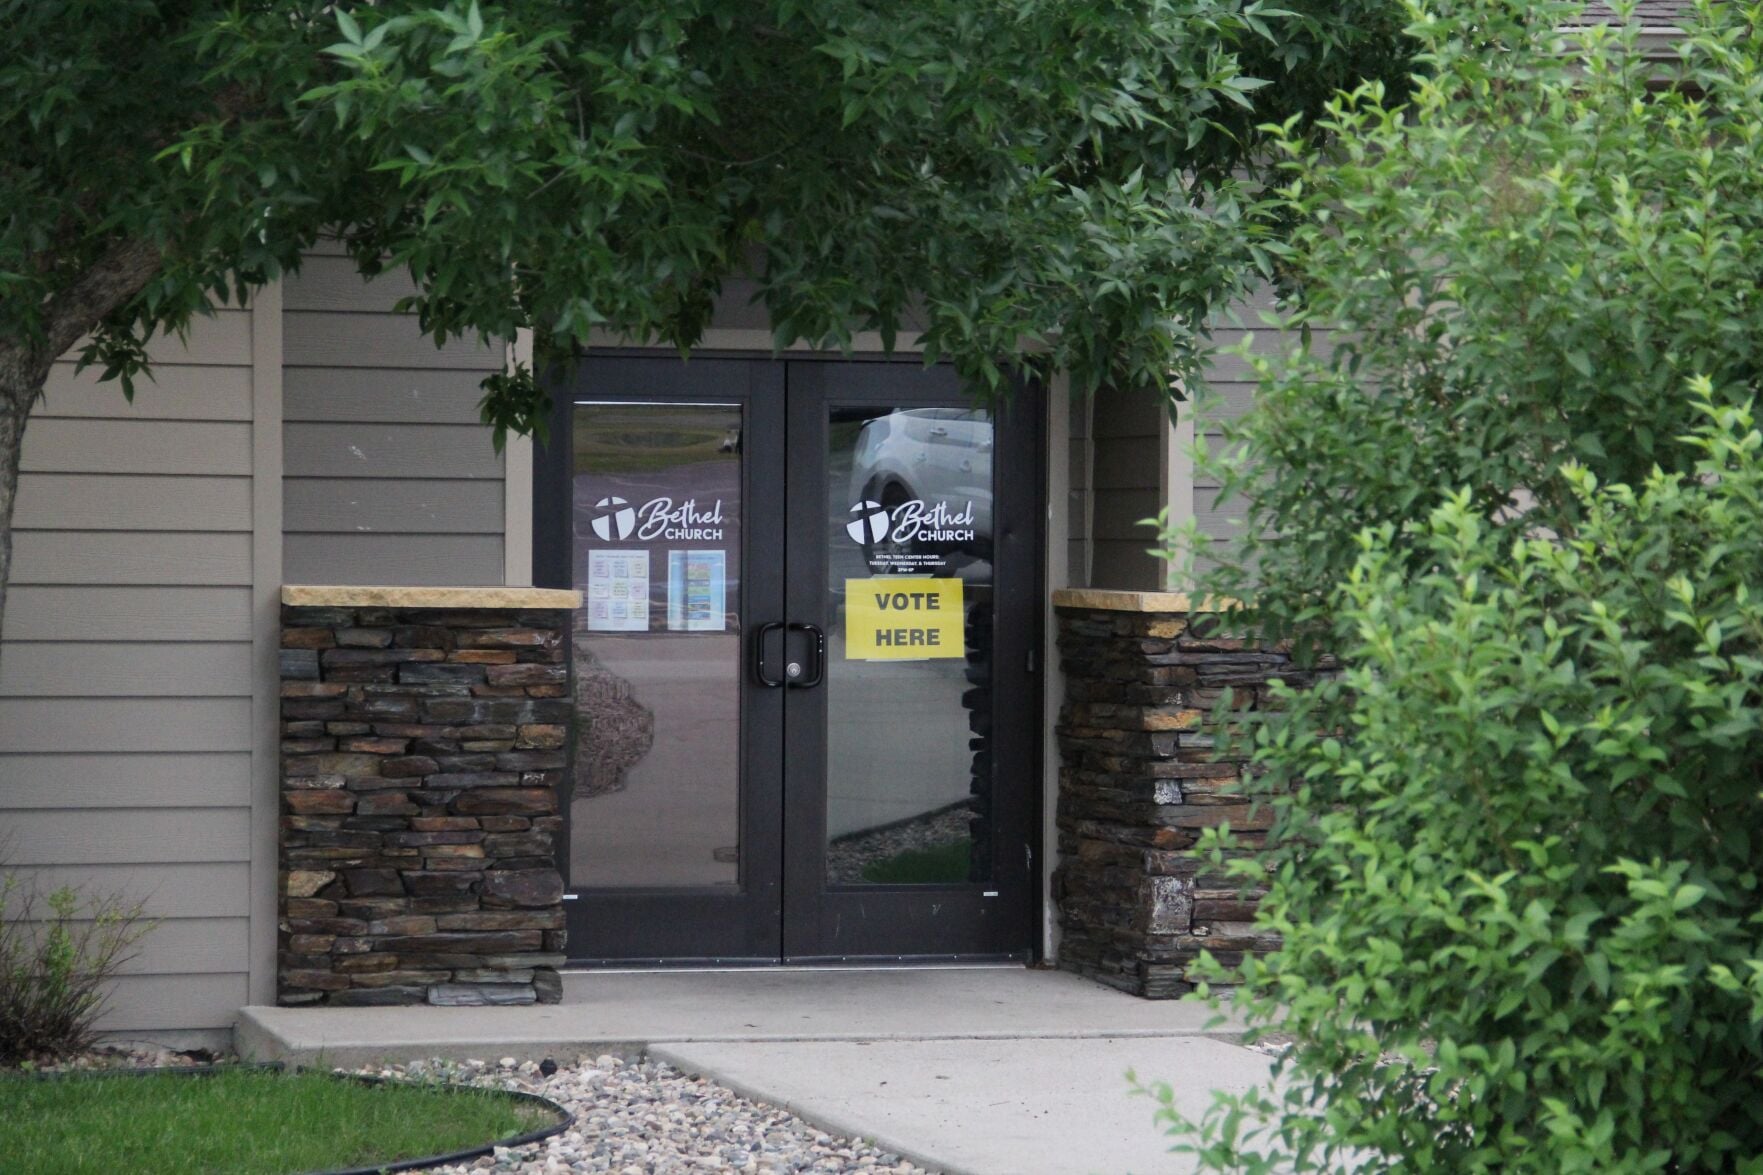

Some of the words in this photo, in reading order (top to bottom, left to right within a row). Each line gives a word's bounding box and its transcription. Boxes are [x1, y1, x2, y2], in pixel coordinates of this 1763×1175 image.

[638, 497, 722, 540] Bethel
[891, 499, 974, 543] Bethel
[665, 528, 722, 540] CHURCH
[918, 530, 974, 542] CHURCH
[875, 592, 940, 610] VOTE
[875, 628, 940, 647] HERE
